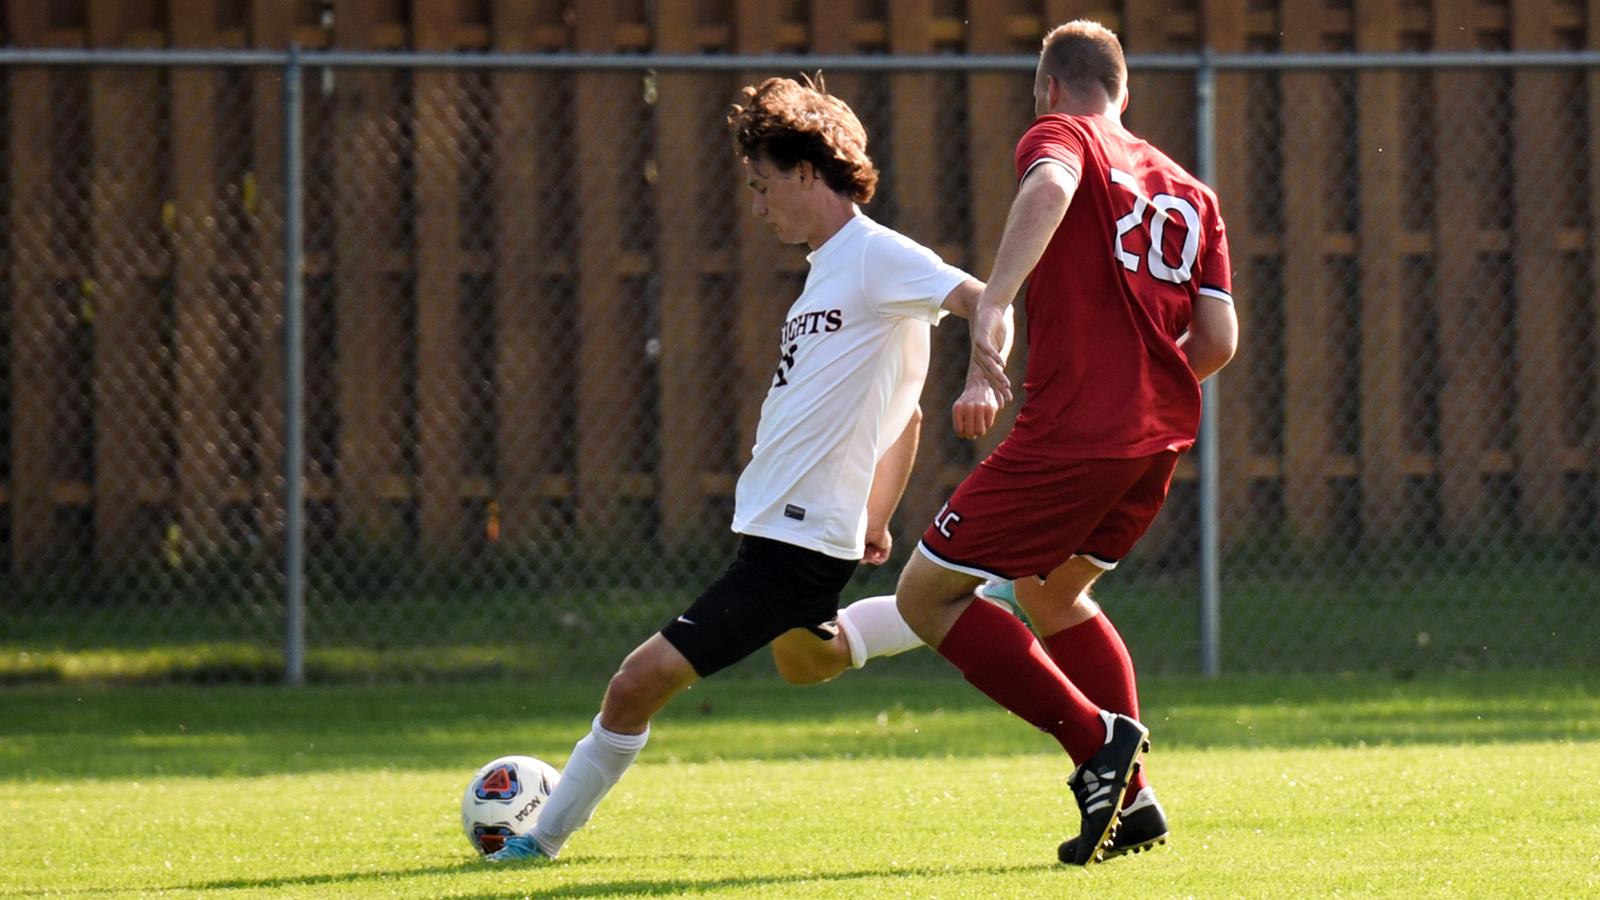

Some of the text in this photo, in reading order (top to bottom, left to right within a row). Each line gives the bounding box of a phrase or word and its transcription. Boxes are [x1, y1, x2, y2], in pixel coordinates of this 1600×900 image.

[1109, 167, 1200, 284] 20
[780, 309, 843, 345] IGHTS
[515, 796, 541, 821] NCAA
